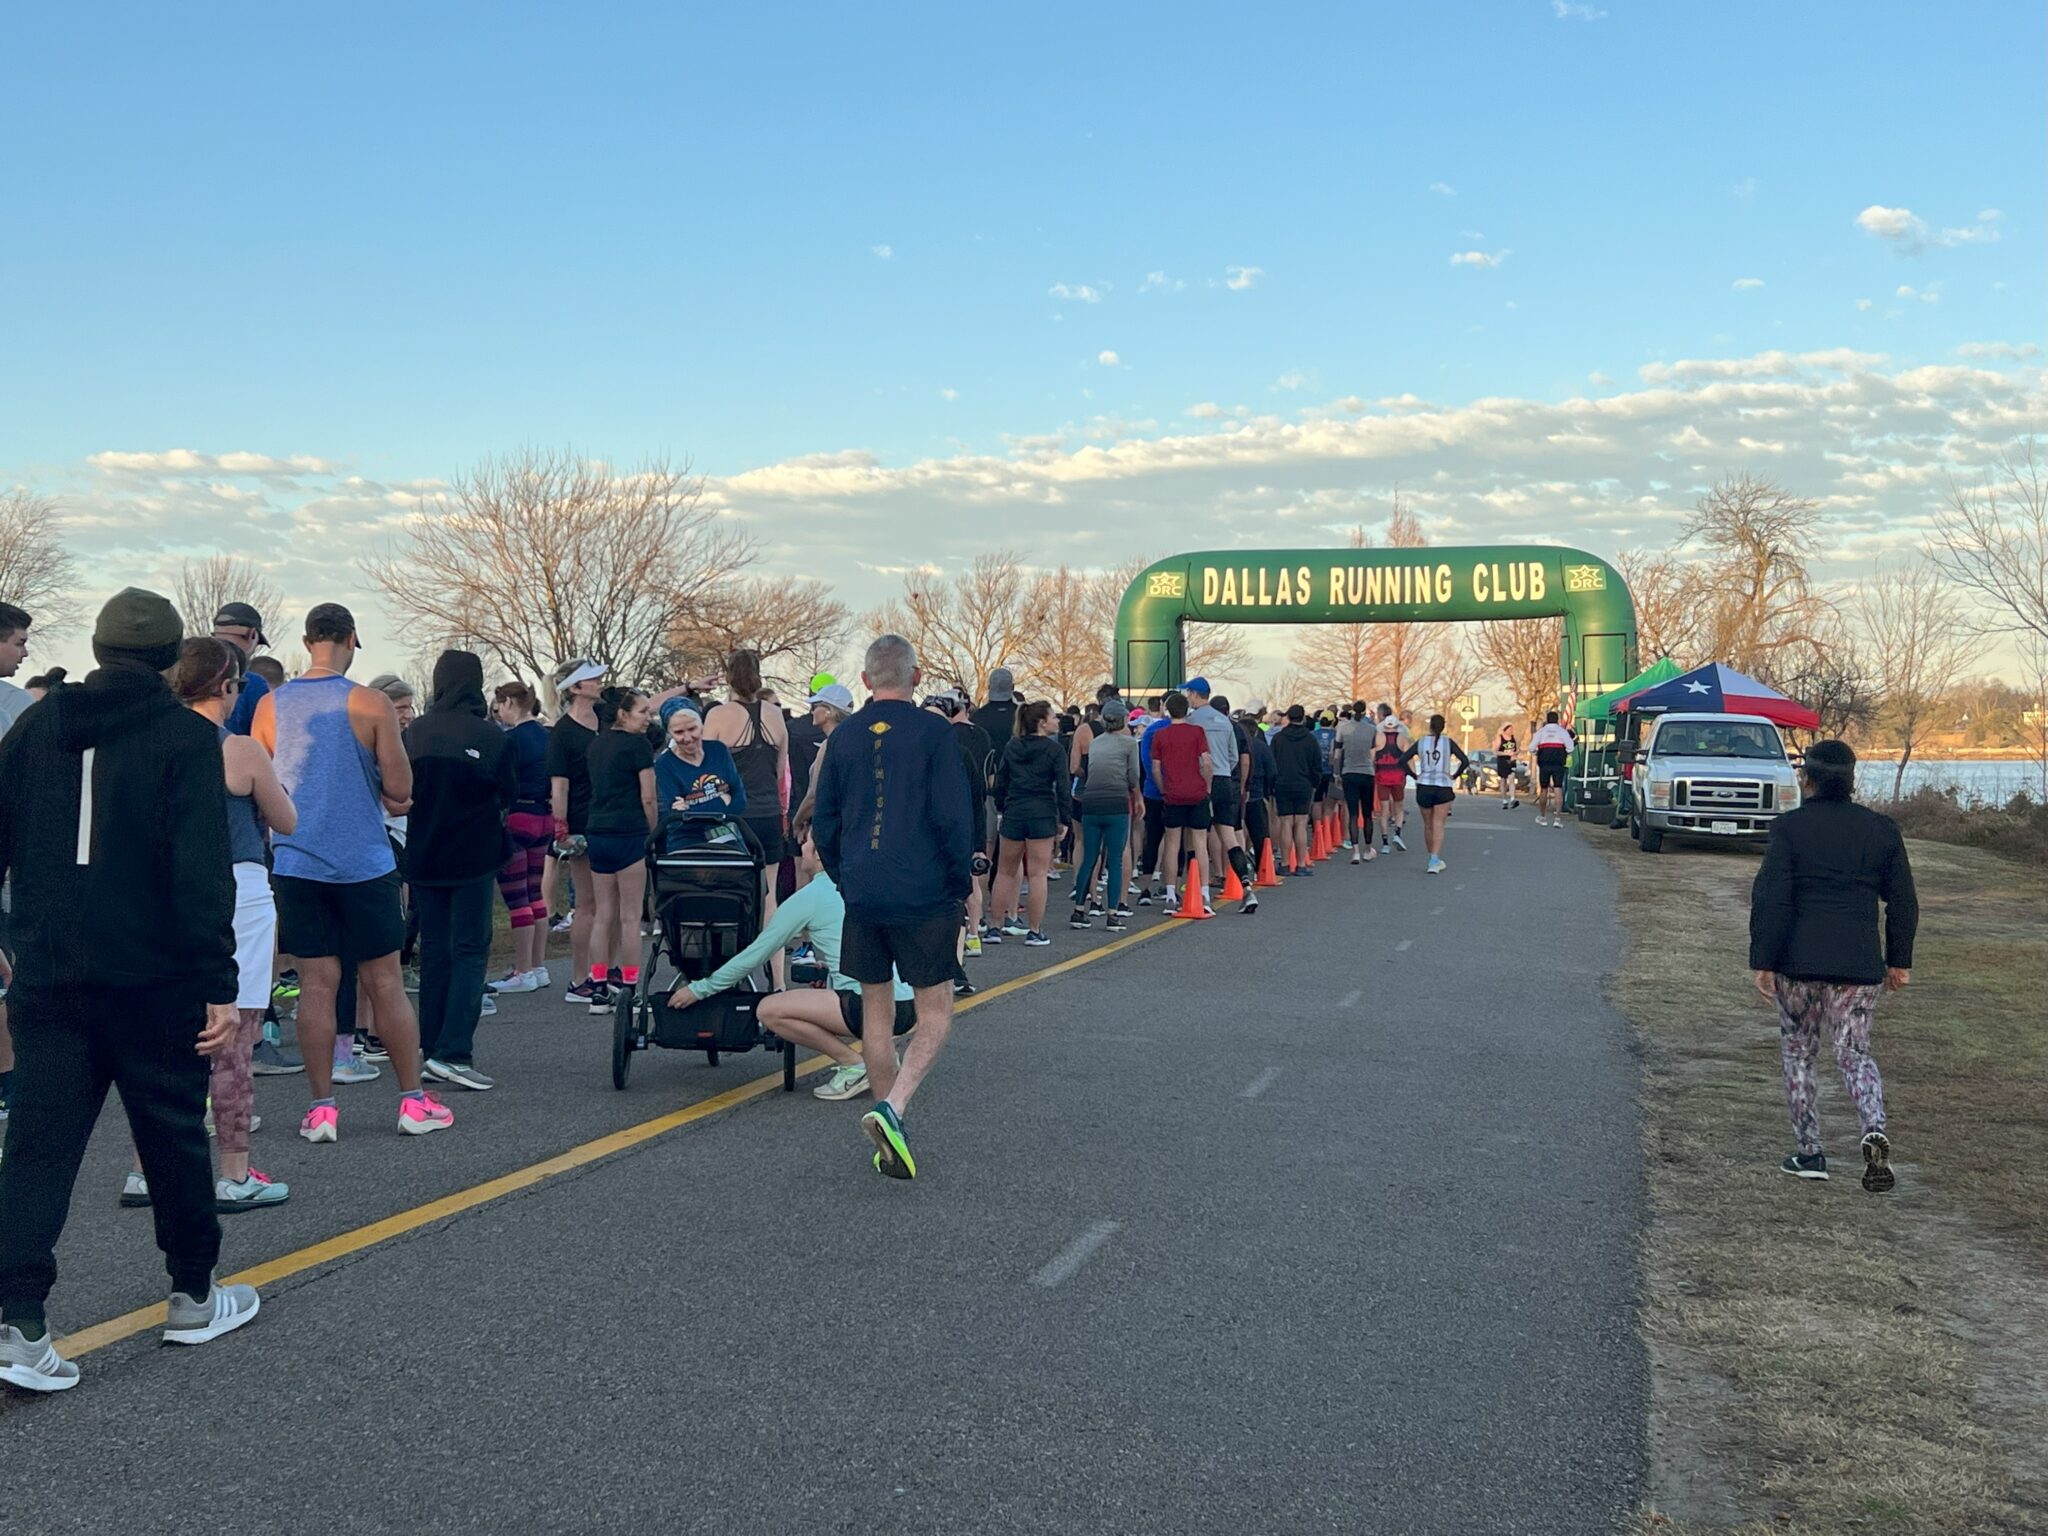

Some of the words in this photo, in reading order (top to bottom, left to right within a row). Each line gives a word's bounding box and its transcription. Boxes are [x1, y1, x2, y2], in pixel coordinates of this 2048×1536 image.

[1203, 566, 1311, 606] DALLAS
[1329, 563, 1452, 605] RUNNING
[1472, 562, 1546, 603] CLUB
[1570, 577, 1603, 589] DRC
[1149, 585, 1182, 596] DRC
[1425, 750, 1441, 766] 19
